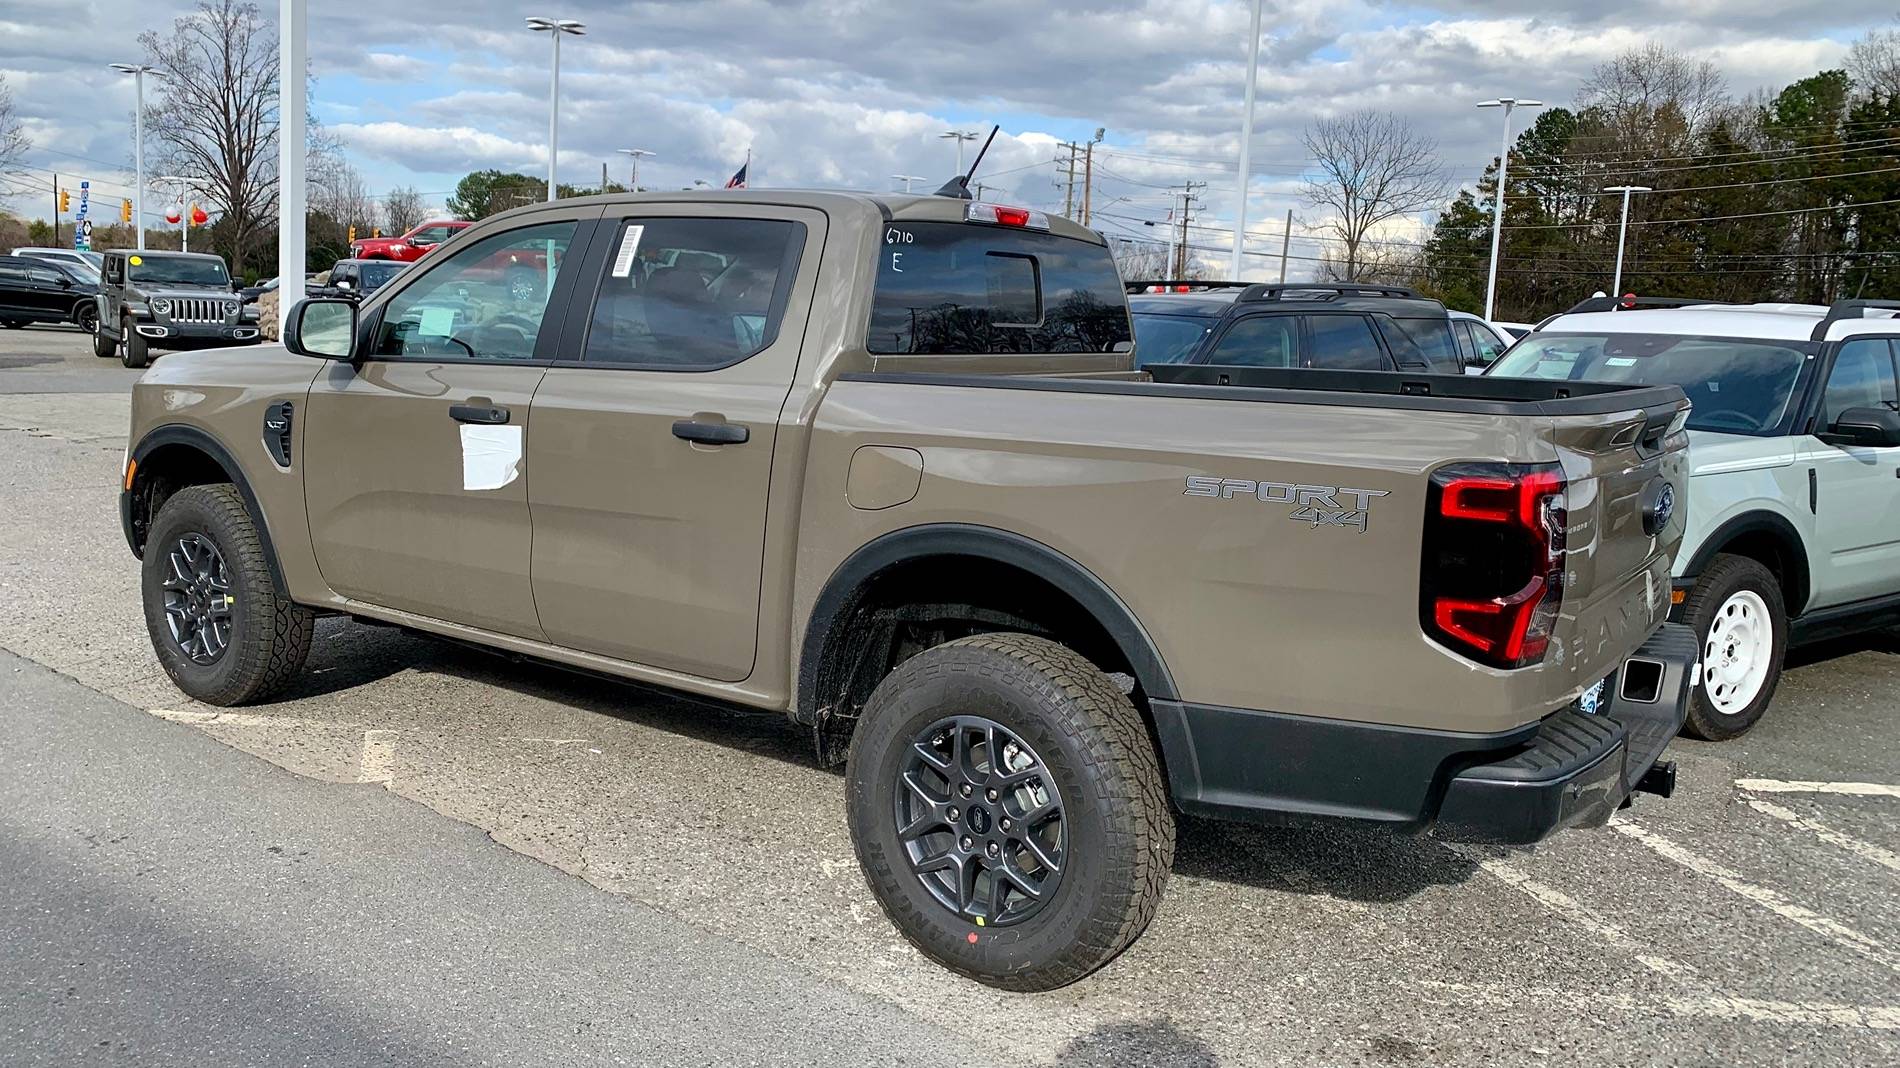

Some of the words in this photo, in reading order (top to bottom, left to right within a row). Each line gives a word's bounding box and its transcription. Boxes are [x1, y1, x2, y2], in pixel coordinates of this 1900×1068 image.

[886, 227, 914, 244] 6710
[892, 252, 904, 273] E
[1183, 475, 1392, 510] SPORT
